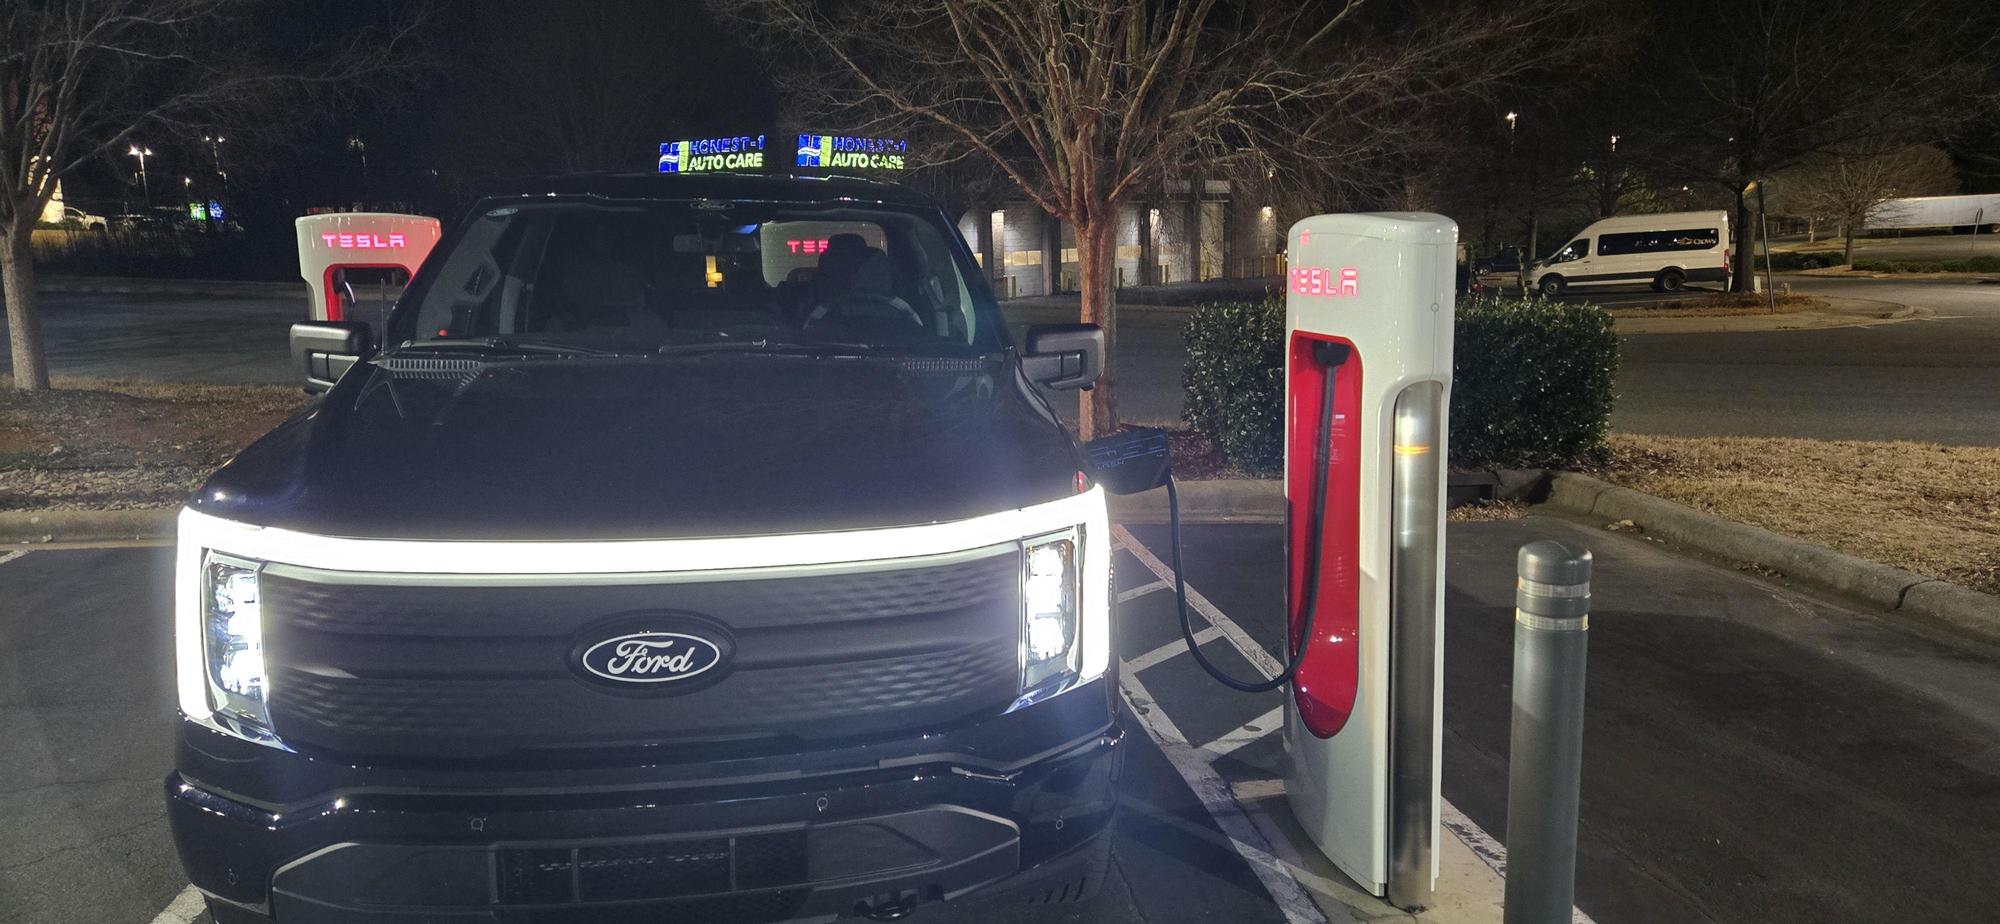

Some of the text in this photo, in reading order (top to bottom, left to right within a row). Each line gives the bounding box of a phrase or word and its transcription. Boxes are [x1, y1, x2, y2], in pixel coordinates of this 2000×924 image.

[690, 134, 766, 155] HONEST-1
[688, 152, 763, 171] AUTO CARE
[831, 152, 905, 169] AUTO CARE
[321, 234, 406, 248] TESLA
[787, 239, 829, 253] TES
[607, 640, 696, 675] Ford
